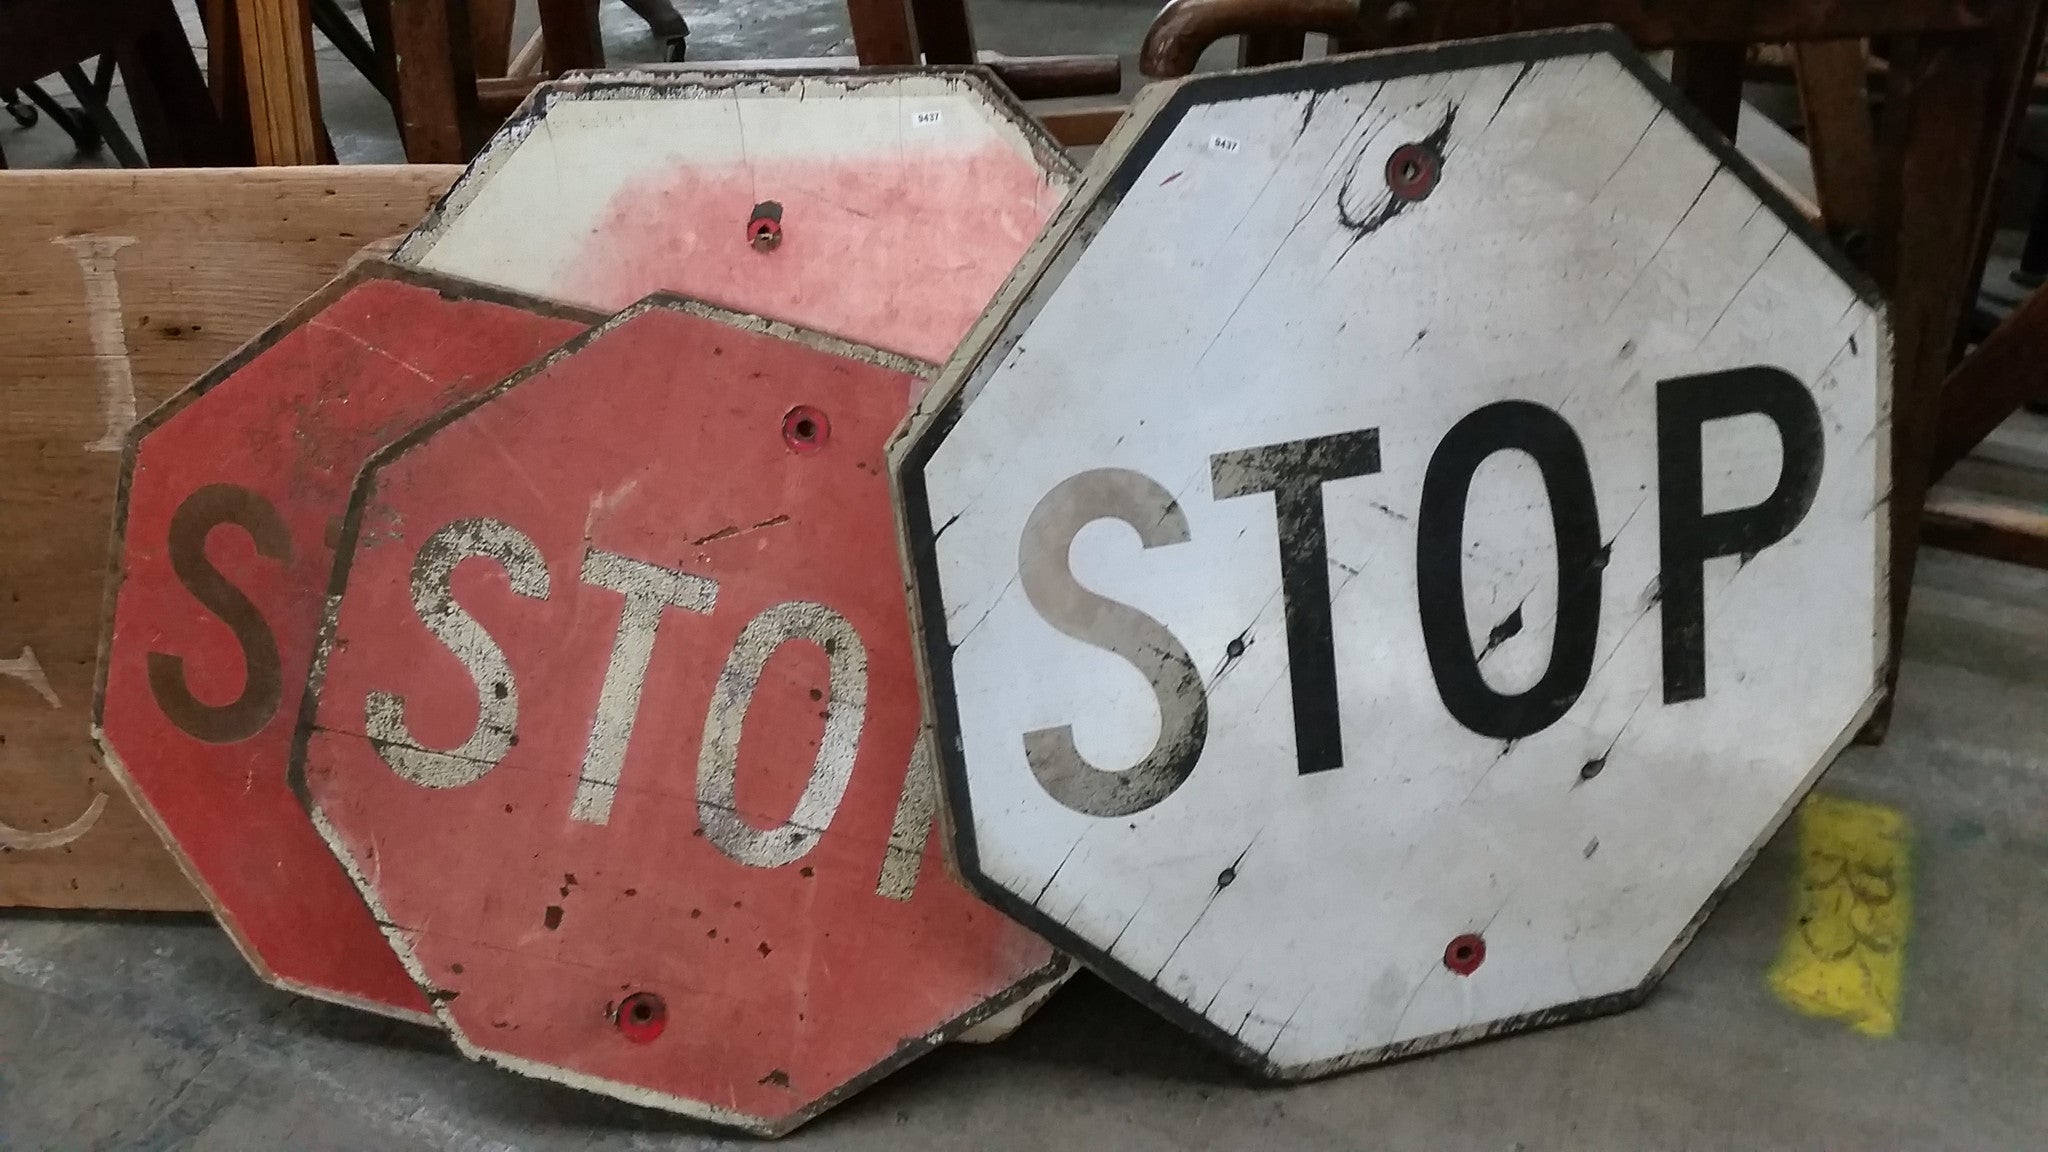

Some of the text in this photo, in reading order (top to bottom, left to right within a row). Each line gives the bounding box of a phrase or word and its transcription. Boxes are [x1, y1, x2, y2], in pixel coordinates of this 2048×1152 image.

[917, 112, 940, 123] 9437
[1214, 136, 1239, 151] 9437
[146, 483, 342, 744] S
[364, 517, 938, 901] STO
[1018, 365, 1825, 817] STOP
